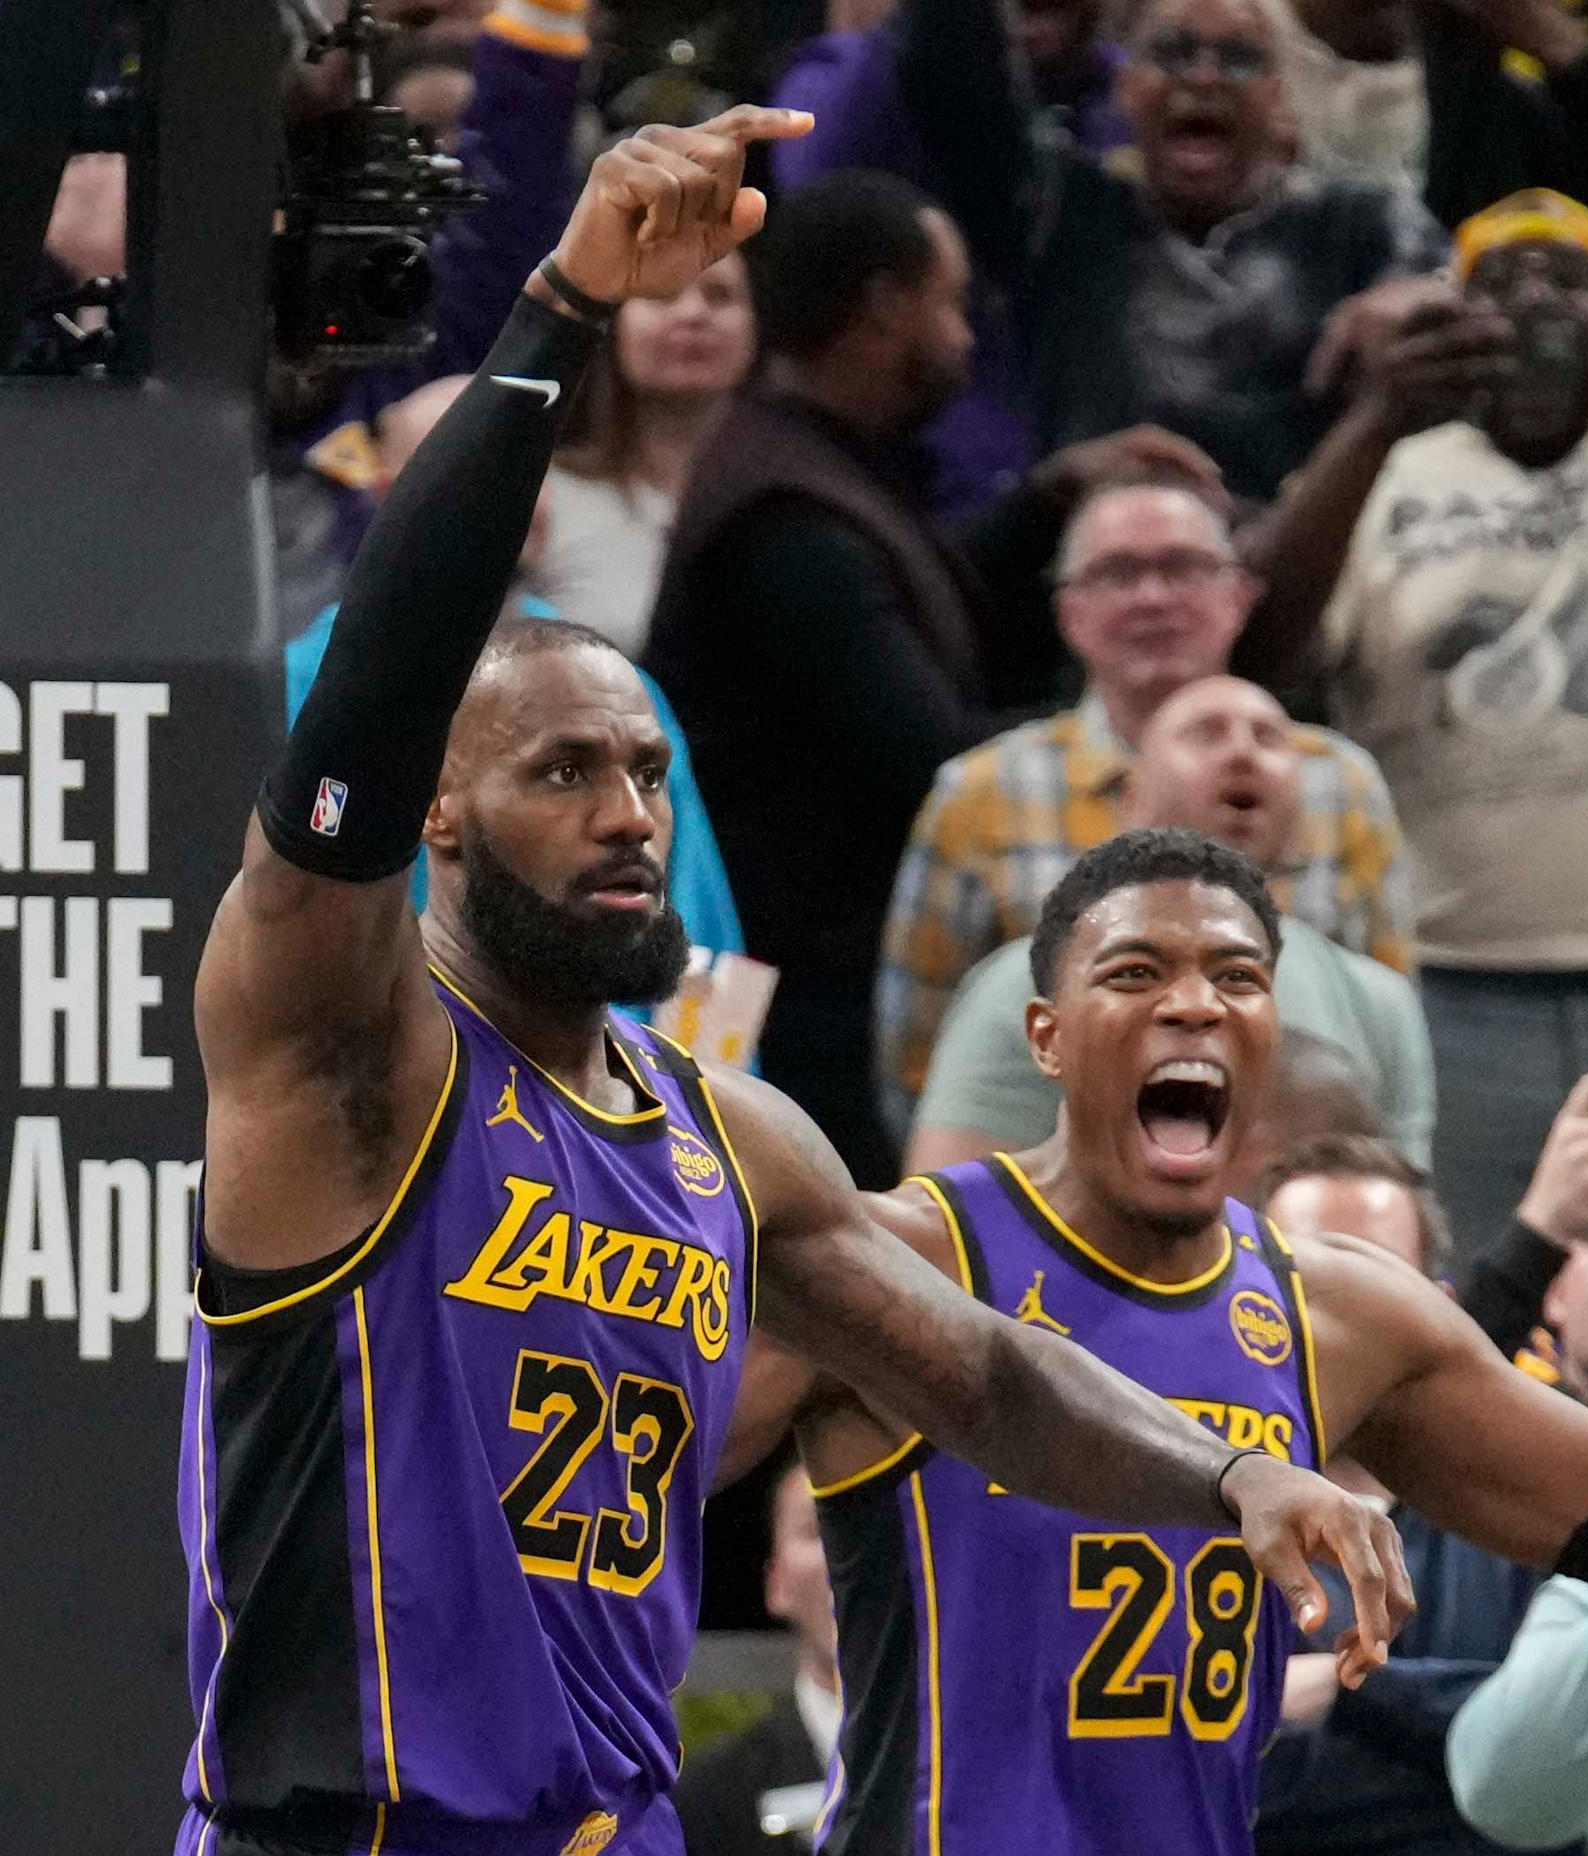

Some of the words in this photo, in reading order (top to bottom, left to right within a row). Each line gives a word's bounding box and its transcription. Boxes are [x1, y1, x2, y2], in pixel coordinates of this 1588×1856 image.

[442, 1175, 732, 1362] LAKERS
[499, 1348, 696, 1598] 23
[1067, 1532, 1264, 1742] 28
